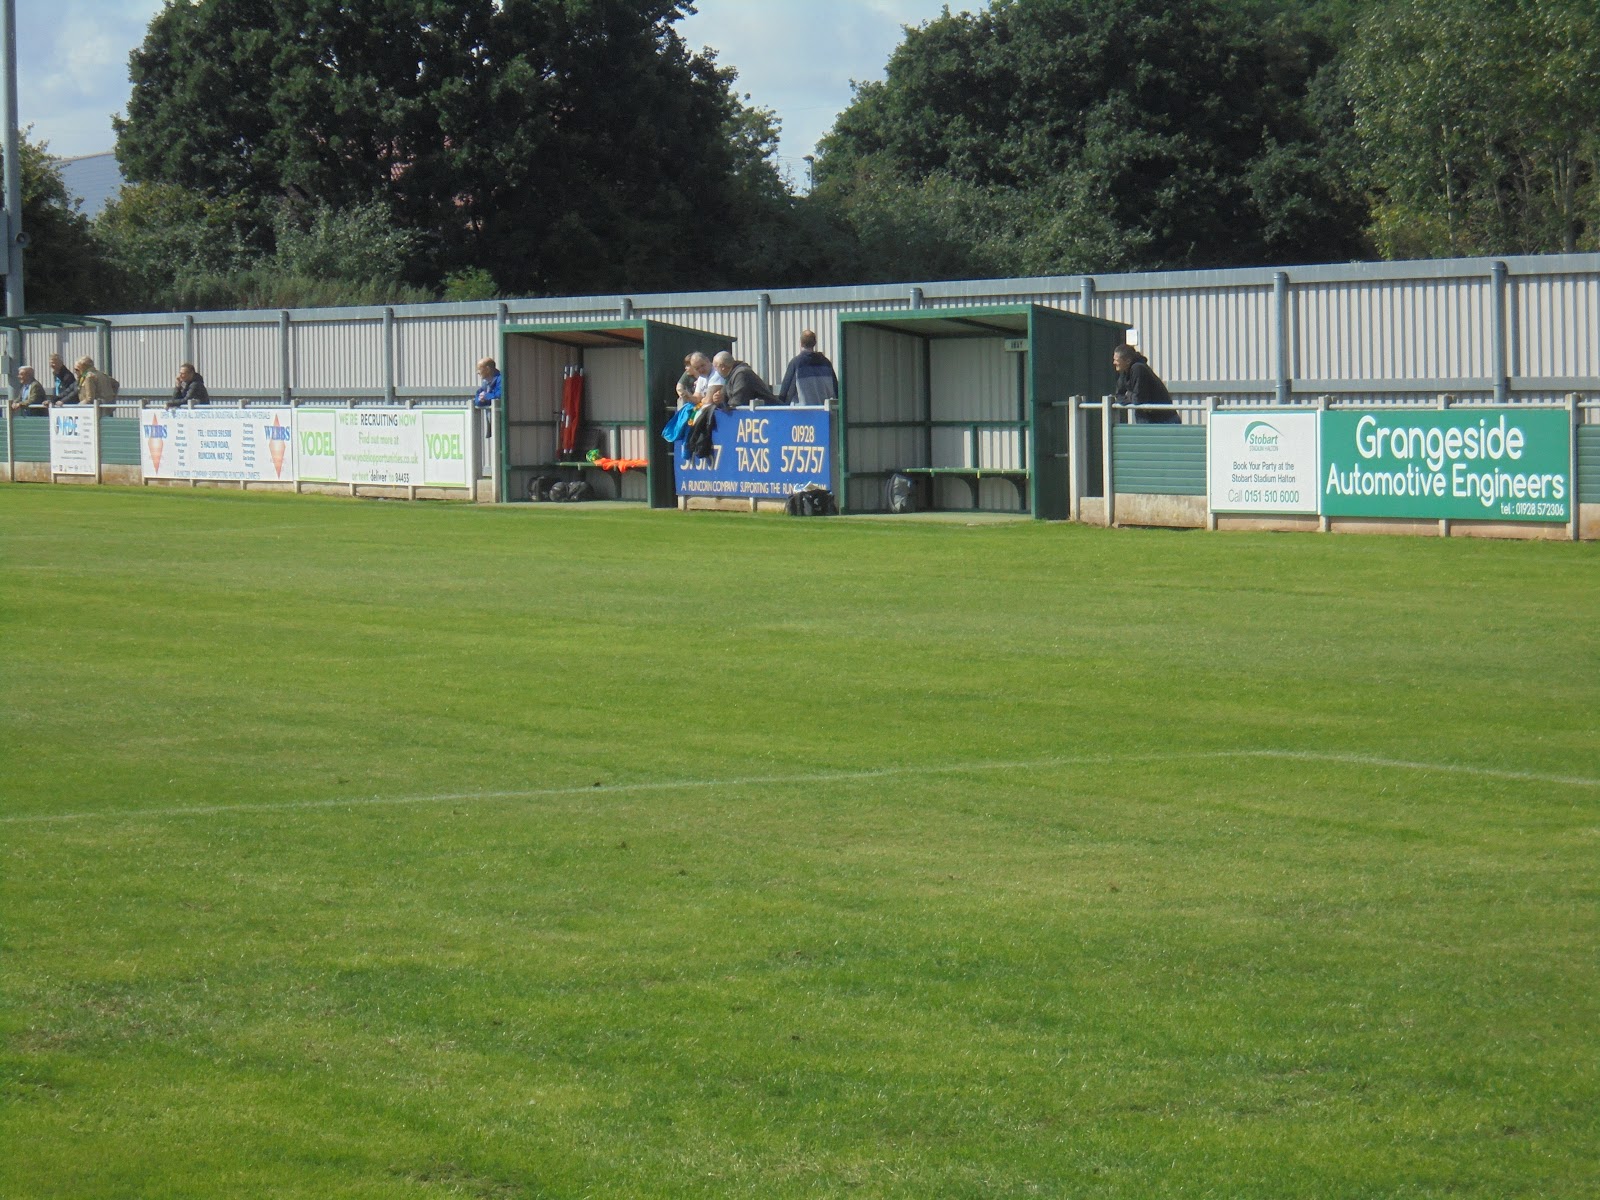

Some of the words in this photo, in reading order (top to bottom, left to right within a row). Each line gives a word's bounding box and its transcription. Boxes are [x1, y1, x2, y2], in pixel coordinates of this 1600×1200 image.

[360, 413, 398, 426] RECRUITING
[399, 414, 416, 427] NOW
[144, 425, 167, 439] WEBBS
[264, 426, 290, 441] WEBBS
[359, 431, 369, 444] Find
[379, 436, 393, 445] more
[736, 418, 769, 444] APEC
[791, 425, 815, 443] 01928
[299, 431, 335, 456] YODEL
[1249, 433, 1279, 445] Stobart
[1355, 414, 1524, 472] Grangeside
[425, 433, 464, 460] YODEL
[735, 447, 770, 473] TAXIS
[780, 445, 825, 474] 575757
[1233, 461, 1247, 471] Book
[1248, 461, 1261, 471] Your
[1261, 461, 1277, 473] Party
[1278, 463, 1284, 471] at
[1285, 461, 1295, 471] the
[1231, 473, 1253, 483] Stobart
[1253, 473, 1277, 483] Stadium
[1277, 474, 1296, 483] Halton
[1325, 462, 1447, 497] Automotive
[1452, 463, 1565, 507] Engineers
[681, 481, 687, 491] A
[688, 481, 712, 492] RUNCORN
[712, 481, 738, 492] COMPANY
[740, 482, 769, 494] SUPPORTING
[770, 482, 780, 494] THE
[1228, 489, 1243, 503] Call
[1244, 489, 1262, 503] 0151
[1264, 490, 1278, 503] 510
[1279, 490, 1300, 503] 6000
[1515, 503, 1536, 515] 01928
[1537, 503, 1565, 516] 572306
